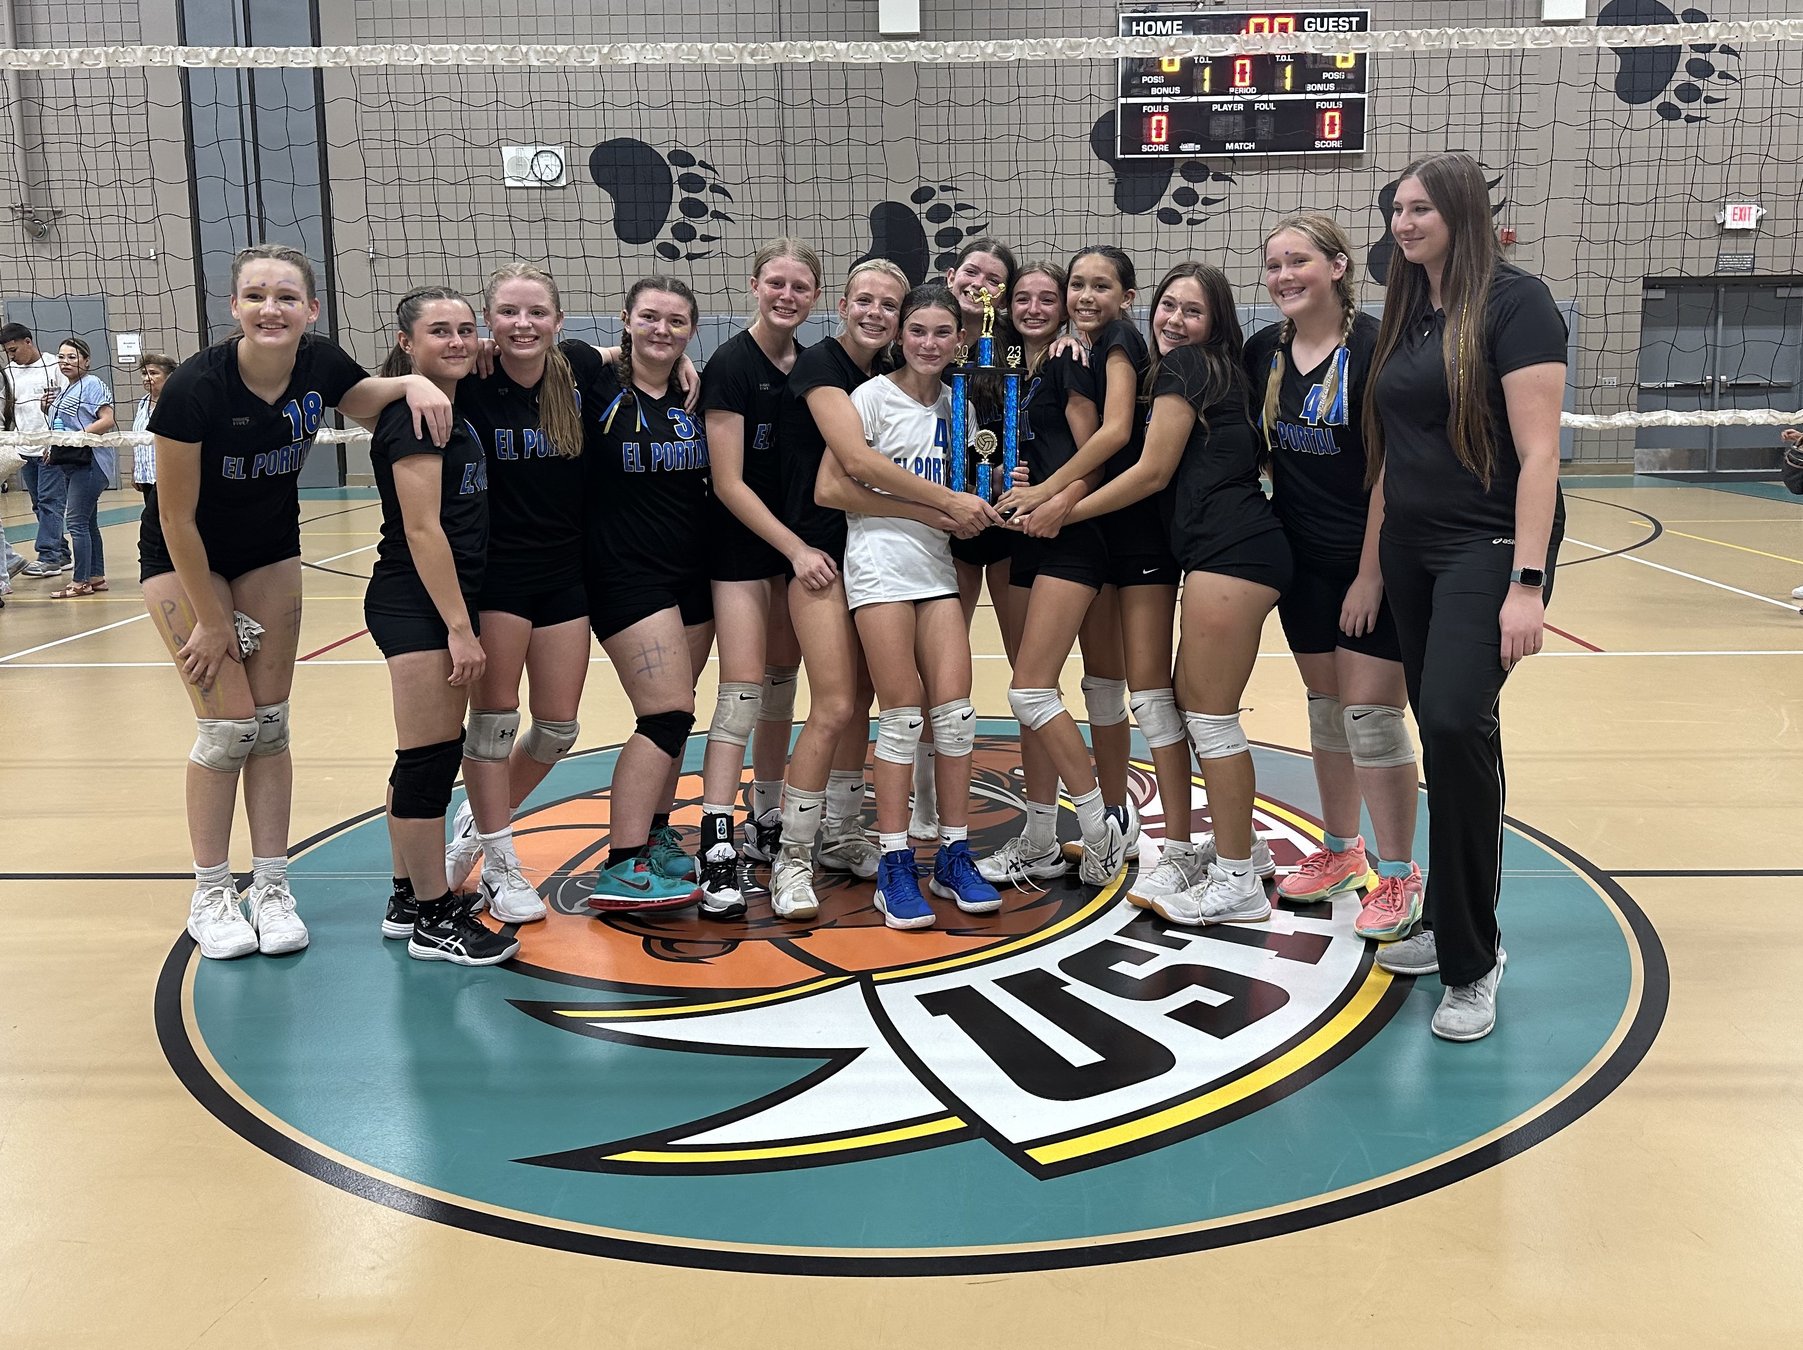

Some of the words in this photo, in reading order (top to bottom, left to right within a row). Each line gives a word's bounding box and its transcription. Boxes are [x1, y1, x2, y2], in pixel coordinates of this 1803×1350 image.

[1132, 21, 1183, 35] HOME
[1304, 17, 1360, 31] GUEST
[1142, 76, 1165, 84] POSS
[1234, 59, 1250, 87] 0
[1322, 72, 1345, 80] POSS
[1151, 87, 1181, 95] BONUS
[1229, 87, 1257, 95] PERIOD
[1142, 105, 1169, 113] FOULS
[1212, 104, 1244, 112] PLAYER
[1254, 103, 1276, 111] FOUL
[1316, 101, 1343, 109] FOULS
[1150, 115, 1168, 142] 0
[1324, 111, 1341, 139] 0
[1732, 206, 1752, 222] EXIT
[1007, 345, 1022, 359] 23
[282, 391, 322, 442] 18
[934, 417, 948, 454] 4
[1277, 420, 1341, 455] PORTAL
[495, 428, 518, 460] EL
[622, 441, 645, 473] EL
[222, 455, 246, 479] EL
